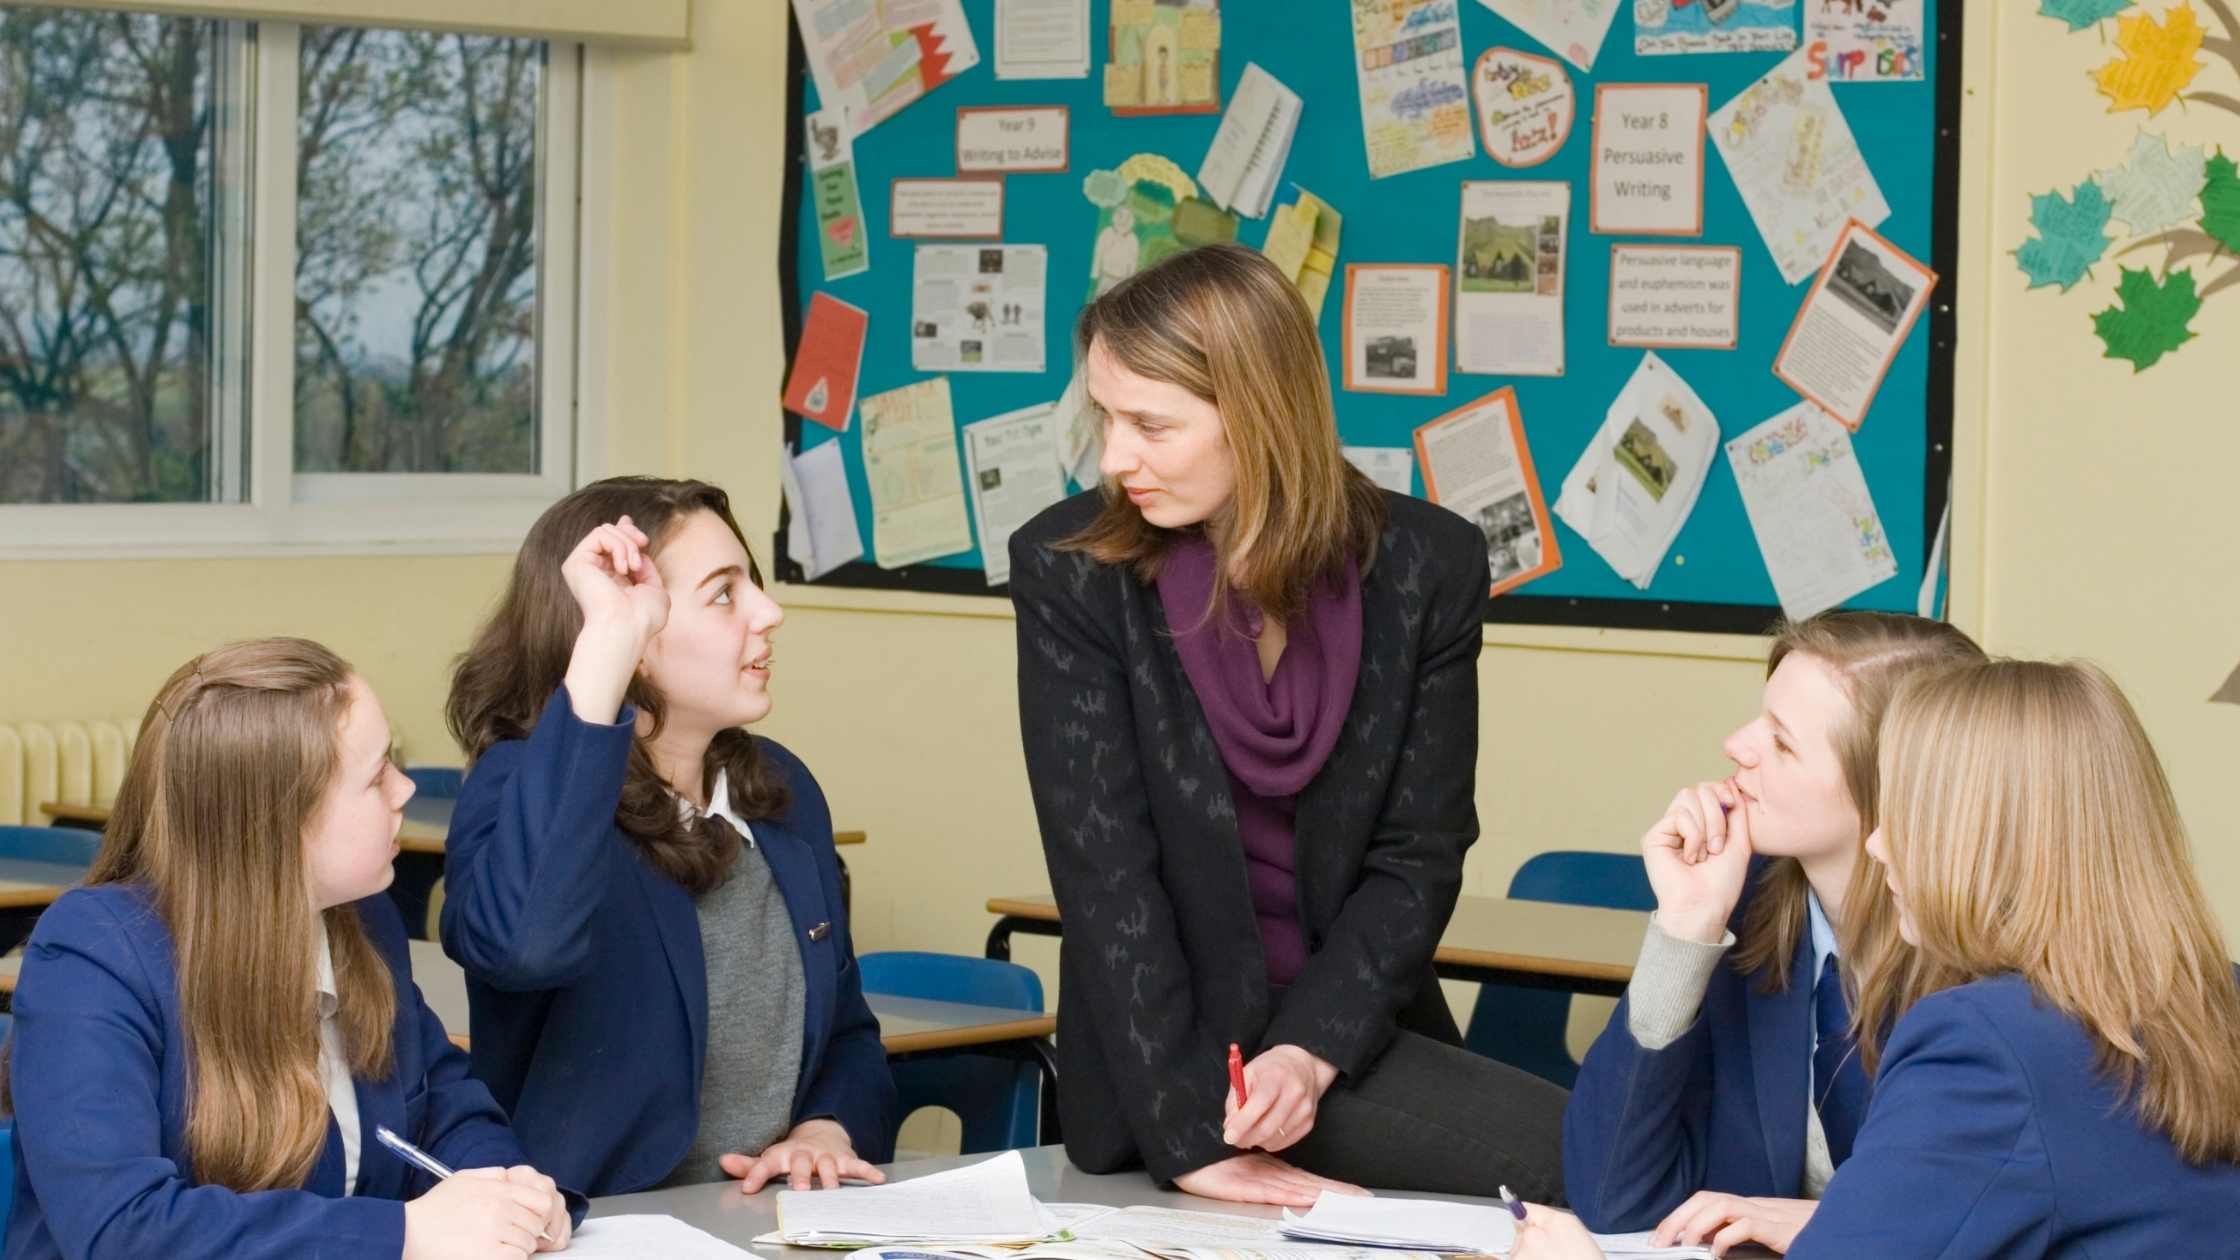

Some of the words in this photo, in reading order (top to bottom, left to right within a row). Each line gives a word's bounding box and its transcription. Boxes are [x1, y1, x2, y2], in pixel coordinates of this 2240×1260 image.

[999, 118, 1024, 133] Year
[1027, 117, 1036, 133] 9
[1621, 112, 1655, 130] Year
[1659, 112, 1670, 130] 8
[963, 146, 1005, 164] Writing
[1008, 146, 1021, 161] to
[1023, 145, 1061, 161] Advise
[1604, 147, 1684, 165] Persuasive
[1613, 181, 1672, 201] Writing
[1620, 253, 1677, 267] Persuasive
[1680, 254, 1731, 269] language
[1618, 277, 1639, 290] and
[1641, 277, 1706, 291] euphemism
[1709, 280, 1731, 290] was
[1622, 300, 1648, 314] used
[1650, 302, 1661, 313] in
[1663, 300, 1706, 314] adverts
[1708, 300, 1725, 314] for
[1615, 324, 1663, 338] products
[1666, 325, 1688, 338] and
[1690, 325, 1731, 338] houses
